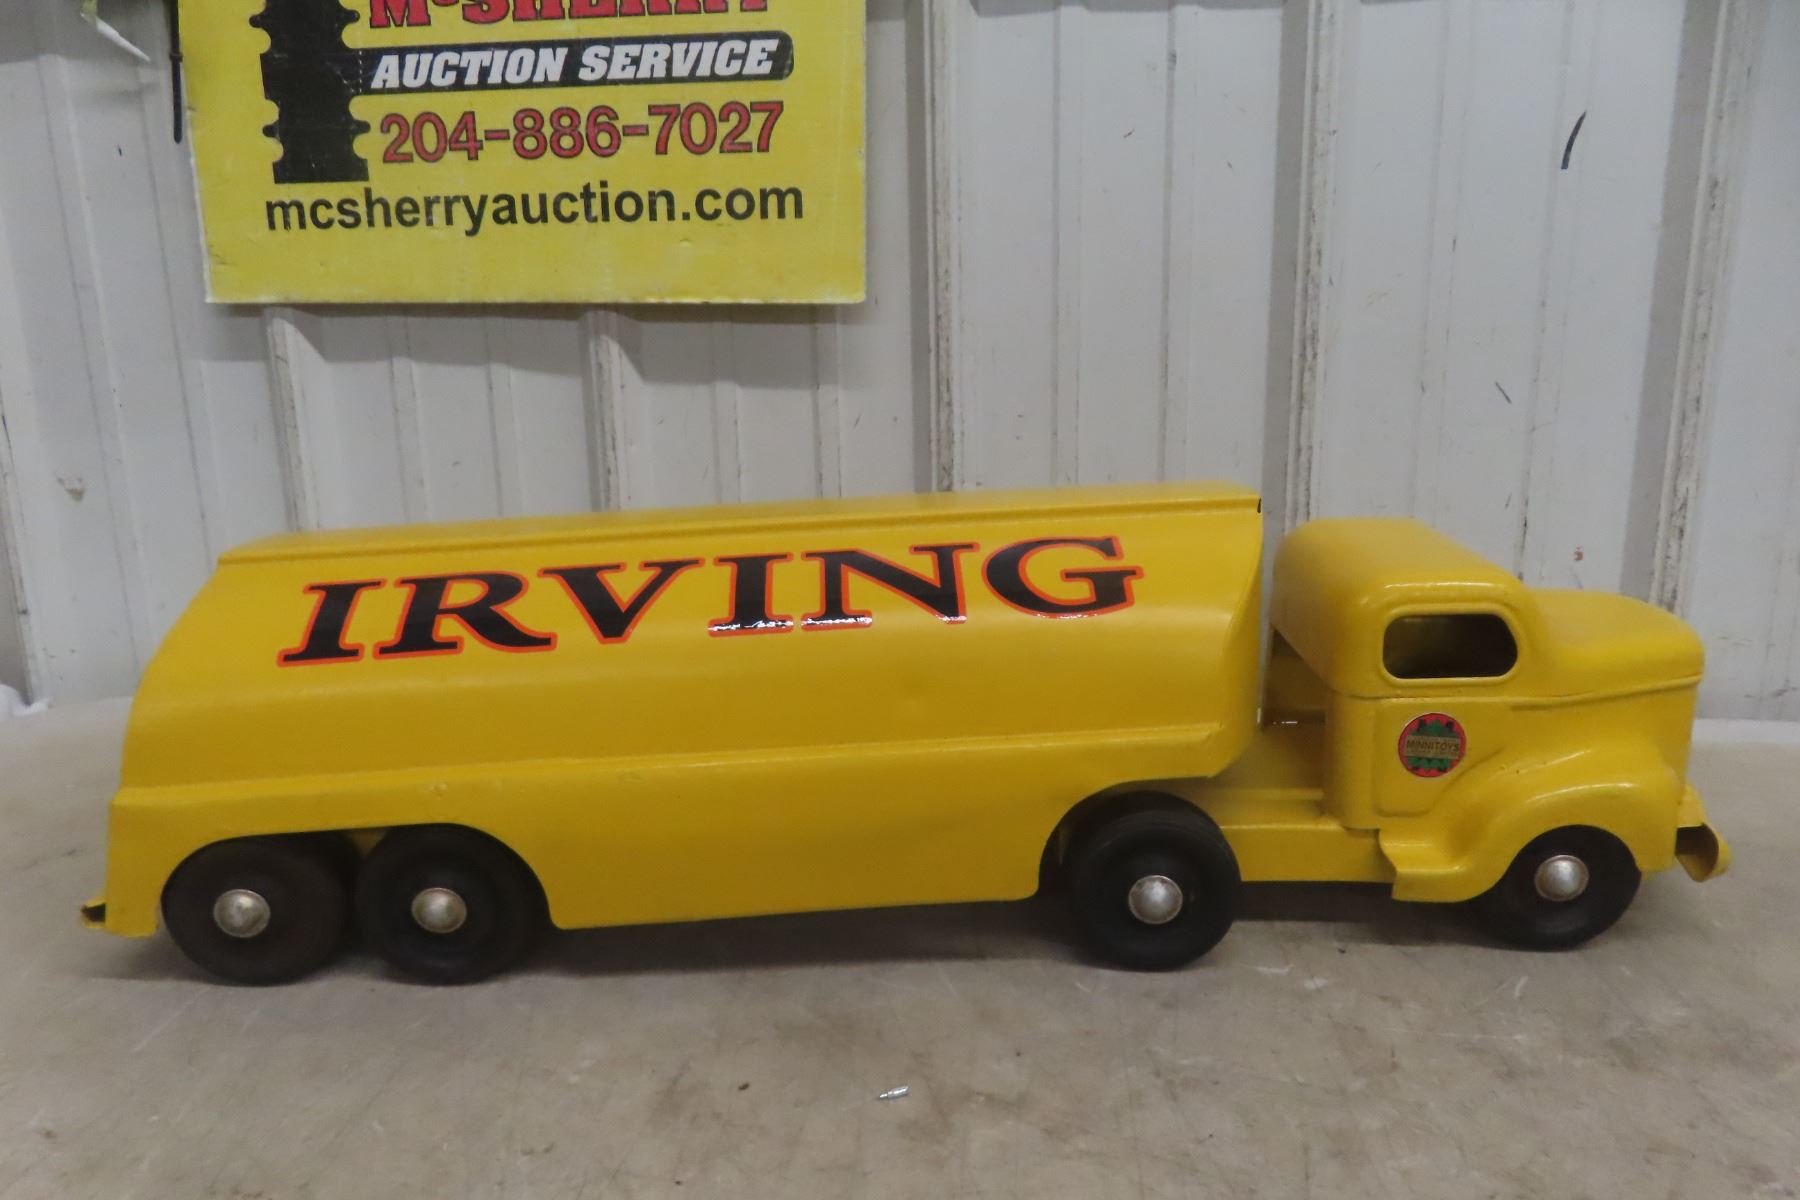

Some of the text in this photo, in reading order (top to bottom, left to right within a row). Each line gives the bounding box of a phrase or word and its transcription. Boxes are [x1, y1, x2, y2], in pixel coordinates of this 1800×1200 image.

[371, 39, 779, 88] AUCTION SERVICE
[380, 101, 785, 163] 204-886-7027
[266, 181, 804, 235] mcsherryauction.com
[278, 536, 1143, 667] IRVING
[1406, 740, 1459, 752] MINNITOYS
